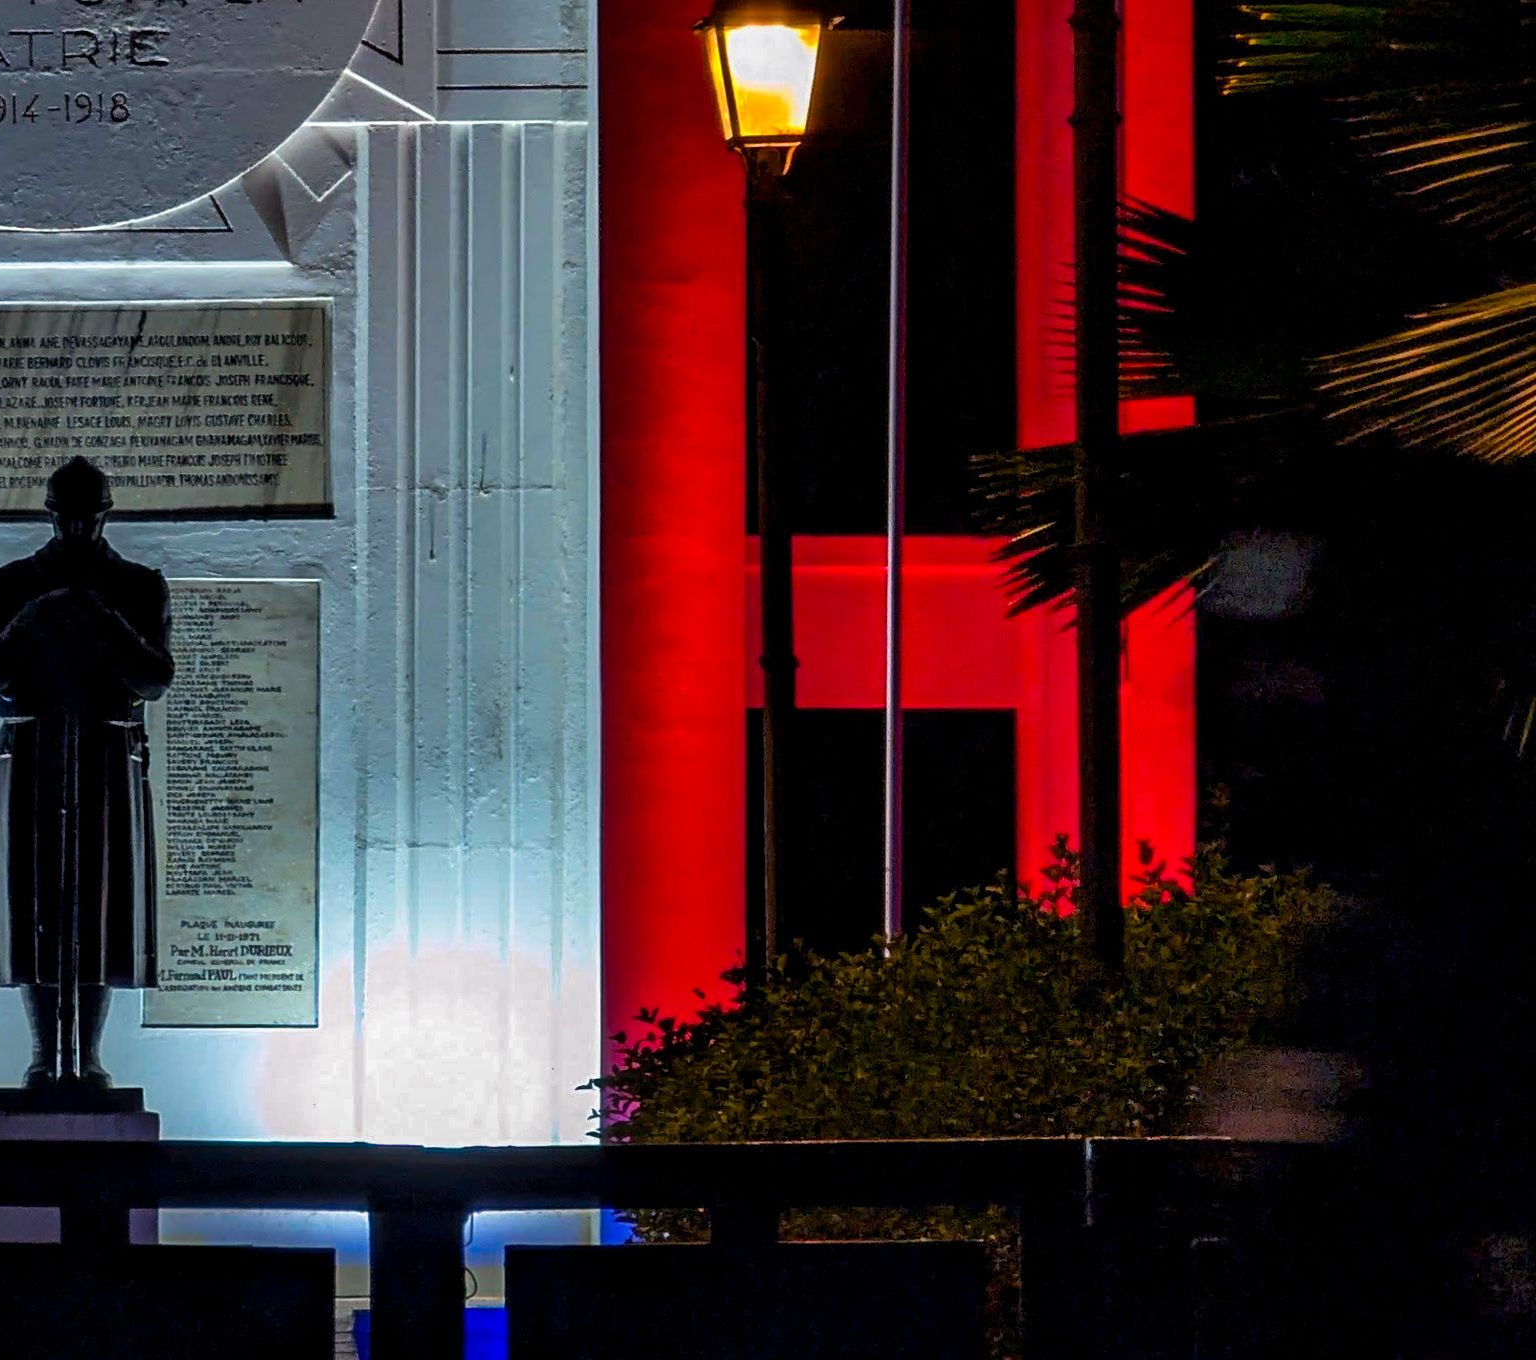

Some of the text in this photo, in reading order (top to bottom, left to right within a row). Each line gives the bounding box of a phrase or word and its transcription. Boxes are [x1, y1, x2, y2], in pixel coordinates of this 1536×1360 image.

[180, 920, 218, 929] PLAQUE
[196, 933, 210, 941] LE
[239, 944, 294, 957] DURIEUX
[207, 969, 238, 981] PAUL
